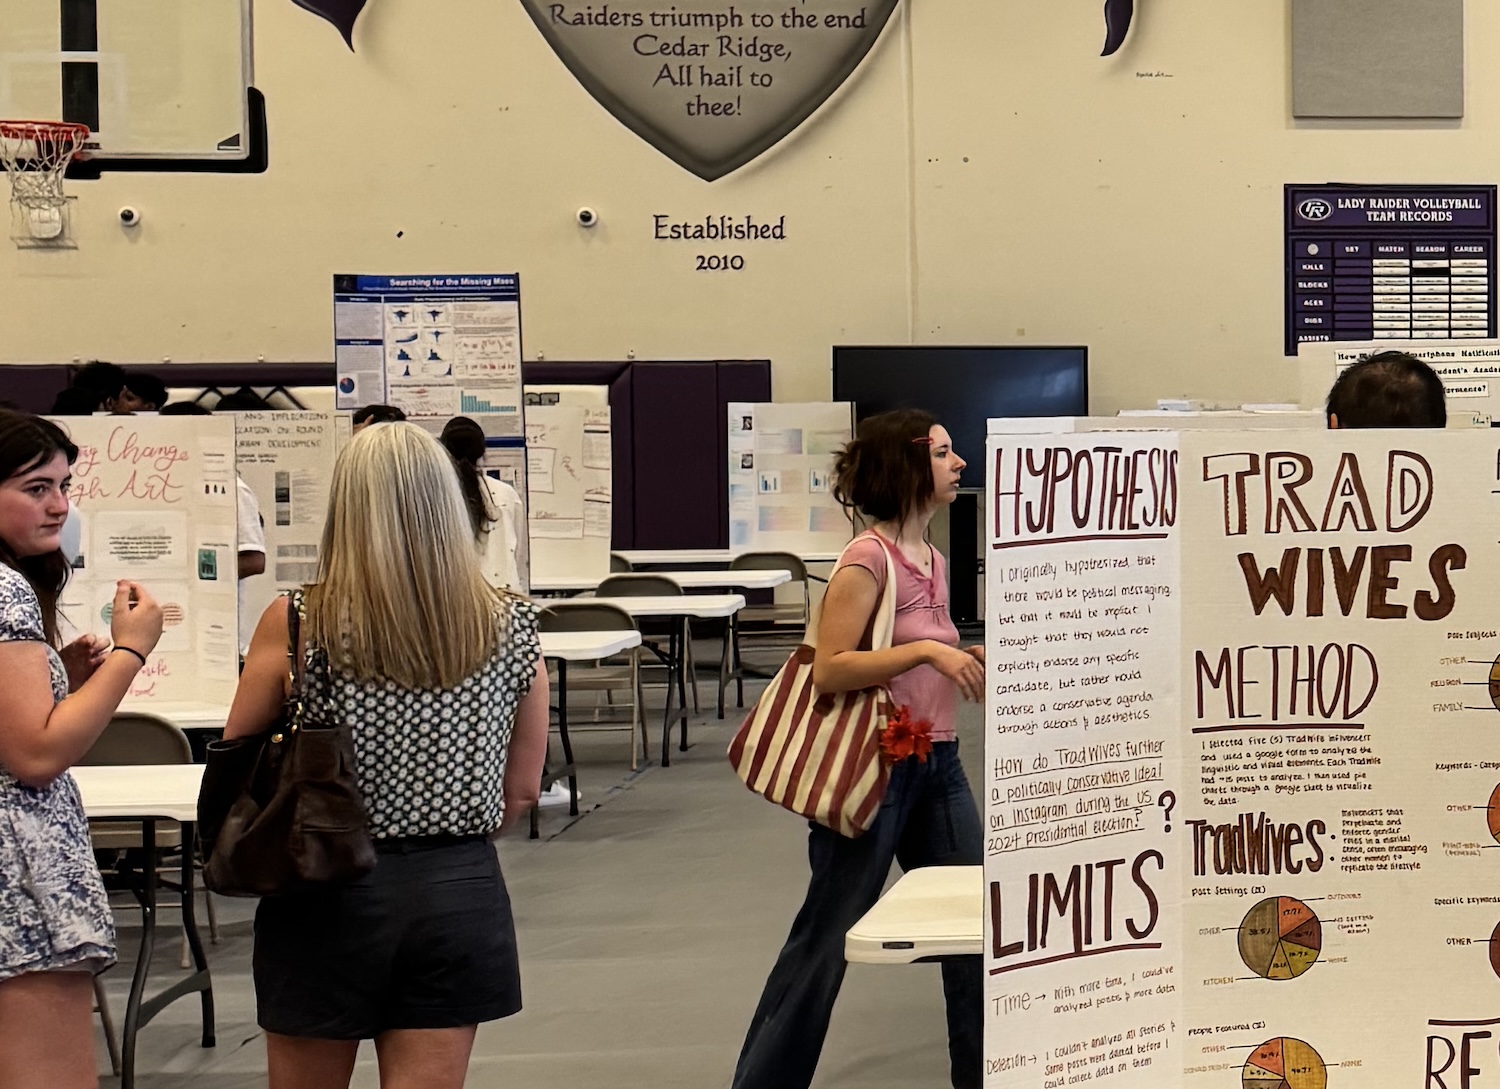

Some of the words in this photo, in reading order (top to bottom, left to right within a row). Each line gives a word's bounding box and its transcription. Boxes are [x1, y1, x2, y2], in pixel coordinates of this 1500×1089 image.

[551, 4, 643, 28] Raiders
[651, 8, 743, 31] triumph
[751, 12, 772, 28] to
[781, 8, 818, 28] the
[825, 8, 867, 29] end
[633, 35, 709, 57] Cedar
[718, 36, 791, 61] Ridge,
[653, 64, 692, 87] All
[701, 66, 741, 87] hail
[751, 69, 772, 87] to
[687, 95, 741, 116] thee!
[1338, 199, 1365, 209] LADY
[1369, 199, 1409, 209] RAIDER
[1414, 199, 1481, 209] VOLLEYBALL
[653, 214, 786, 240] Established
[1367, 211, 1395, 221] TEAM
[1400, 211, 1452, 221] RECORDS
[696, 255, 744, 270] 2010
[390, 279, 430, 287] Searching
[1433, 367, 1468, 375] tudent's
[108, 426, 188, 470] Change
[118, 470, 182, 501] Art
[995, 446, 1178, 538] HYPOTHESIS
[1203, 450, 1433, 536] TRAD
[1009, 562, 1057, 582] originally
[1066, 557, 1129, 575] hypothesized
[1137, 556, 1155, 566] that
[1237, 544, 1467, 620] WIVES
[1005, 591, 1028, 602] there
[1067, 587, 1077, 598] be
[1083, 586, 1116, 602] political
[1000, 634, 1039, 651] thought
[1074, 629, 1092, 642] they
[1098, 627, 1125, 638] would
[1131, 626, 1148, 635] not
[998, 660, 1039, 674] explicitly
[1044, 657, 1079, 668] endorse
[1083, 655, 1100, 665] any
[1107, 649, 1139, 664] specific
[997, 682, 1053, 695] candidate,
[1059, 678, 1075, 689] but
[1081, 674, 1109, 687] rather
[1196, 642, 1378, 721] METHOD
[997, 703, 1033, 717] endorse
[1053, 698, 1112, 711] conservative
[1117, 692, 1153, 705] agenda
[1433, 702, 1463, 712] FAMILY
[998, 721, 1038, 735] through
[1043, 717, 1077, 729] actions
[1270, 735, 1283, 744] (5)
[995, 758, 1022, 778] How
[1033, 753, 1048, 770] do
[1126, 739, 1164, 756] further
[1201, 754, 1216, 762] and
[1223, 752, 1242, 761] used
[1201, 764, 1239, 775] linguistic
[1261, 760, 1283, 769] visual
[1327, 757, 1346, 766] Each
[992, 789, 999, 801] a
[1008, 780, 1062, 803] politically
[1067, 767, 1130, 791] conservative
[1231, 784, 1260, 795] through
[990, 814, 1004, 828] on
[1013, 802, 1067, 825] Instagram
[1076, 796, 1110, 814] during
[1114, 794, 1129, 808] the
[1137, 790, 1152, 804] US
[988, 834, 1021, 852] 2024
[1027, 821, 1087, 847] presidential
[1093, 809, 1143, 834] election?
[990, 849, 1163, 959] LIMITS
[1446, 937, 1472, 945] OTHER
[1054, 999, 1092, 1014] analyzed
[1156, 984, 1175, 994] data
[1080, 982, 1100, 994] more
[992, 992, 1031, 1016] Time
[1137, 1041, 1160, 1053] before
[987, 1054, 1026, 1075] Deletion
[1045, 1077, 1065, 1089] could
[1068, 1072, 1092, 1085] collect
